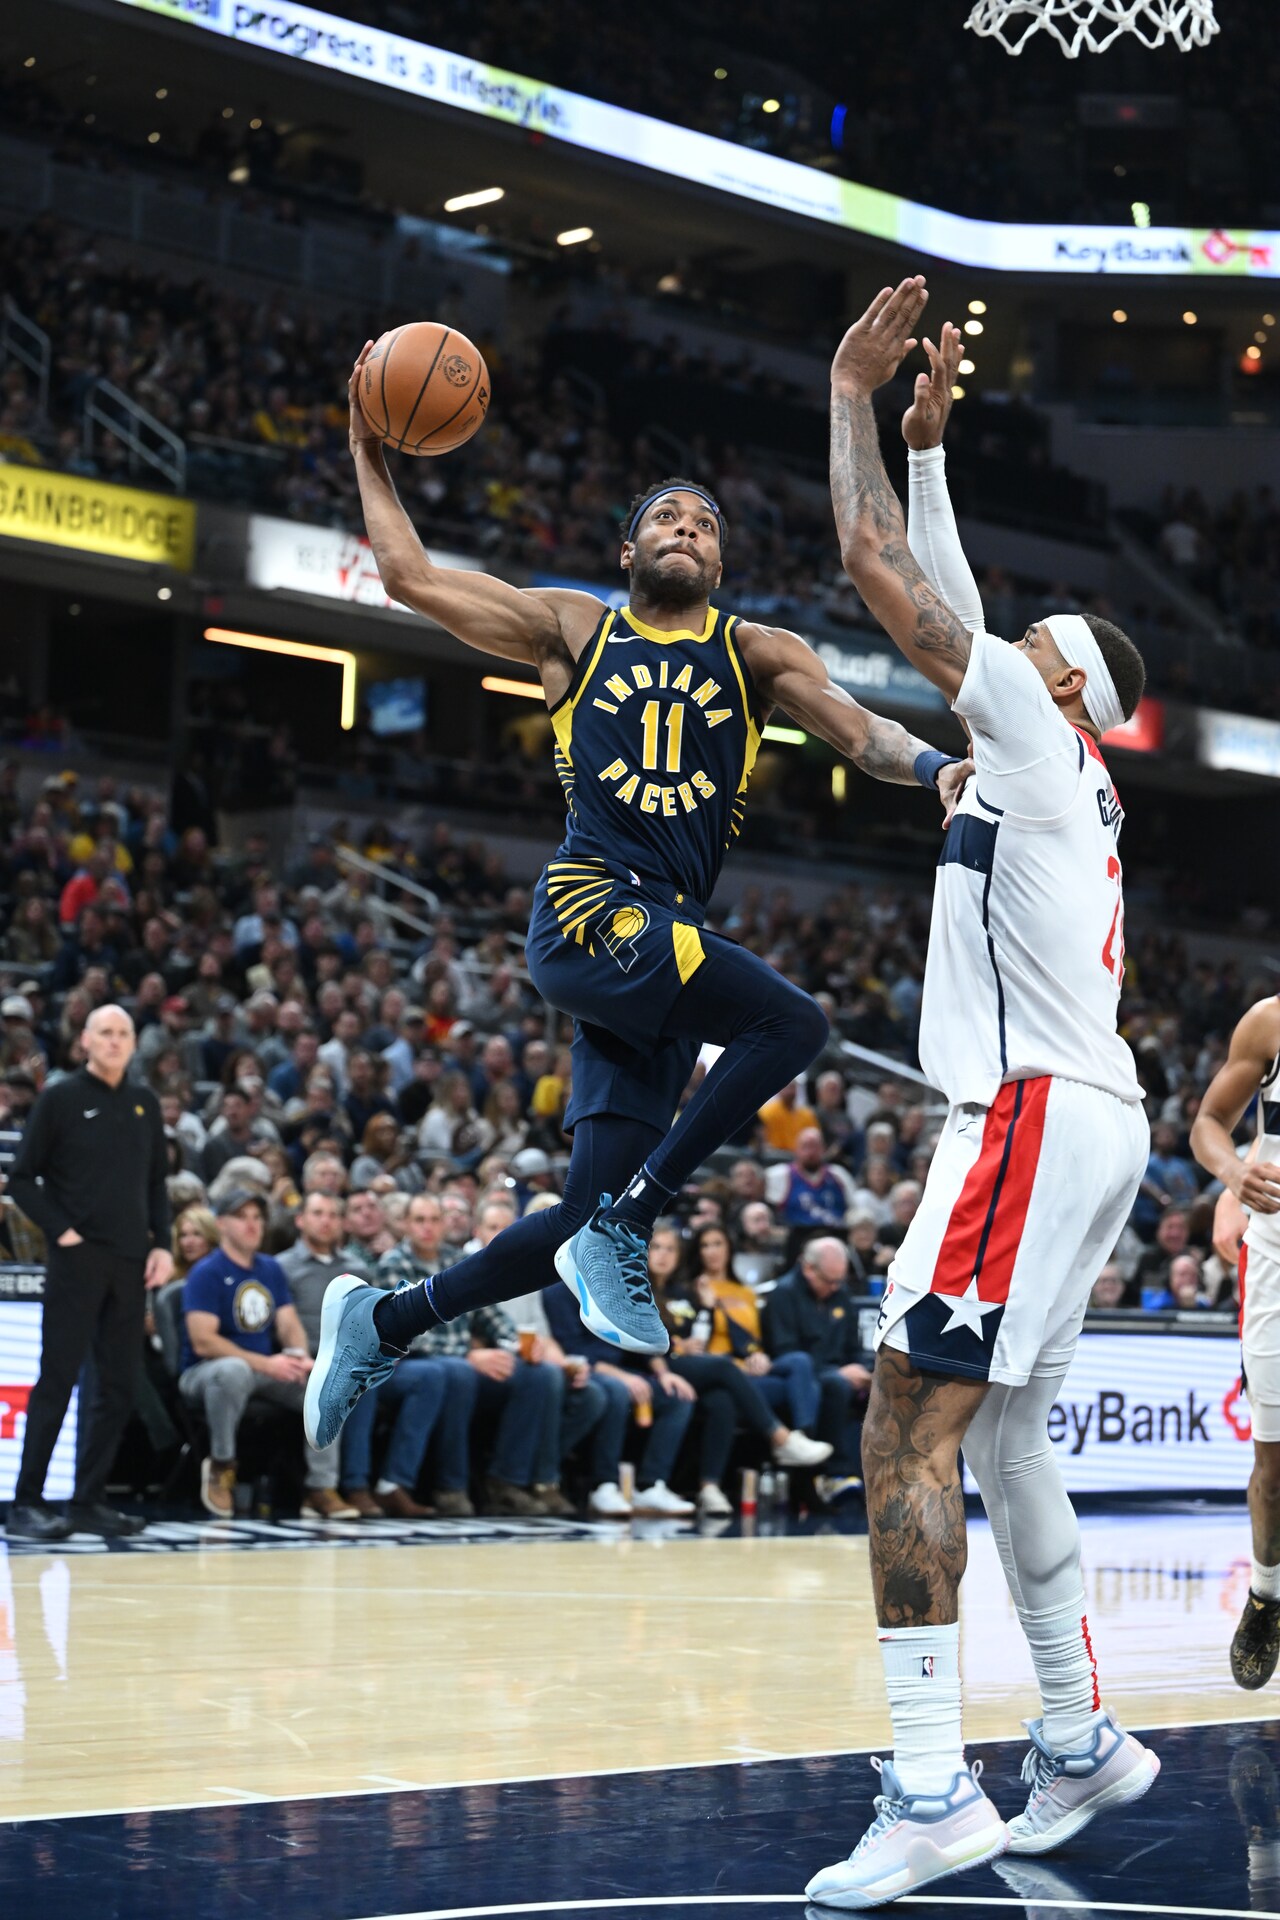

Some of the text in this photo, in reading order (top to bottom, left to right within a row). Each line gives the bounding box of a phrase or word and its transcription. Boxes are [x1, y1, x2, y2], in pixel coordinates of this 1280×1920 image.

[234, 4, 374, 67] progress
[1055, 240, 1193, 273] KeyBank
[592, 660, 733, 729] INDIANA
[640, 700, 685, 773] 11
[597, 757, 717, 817] PACERS
[1047, 1390, 1211, 1455] eyBank
